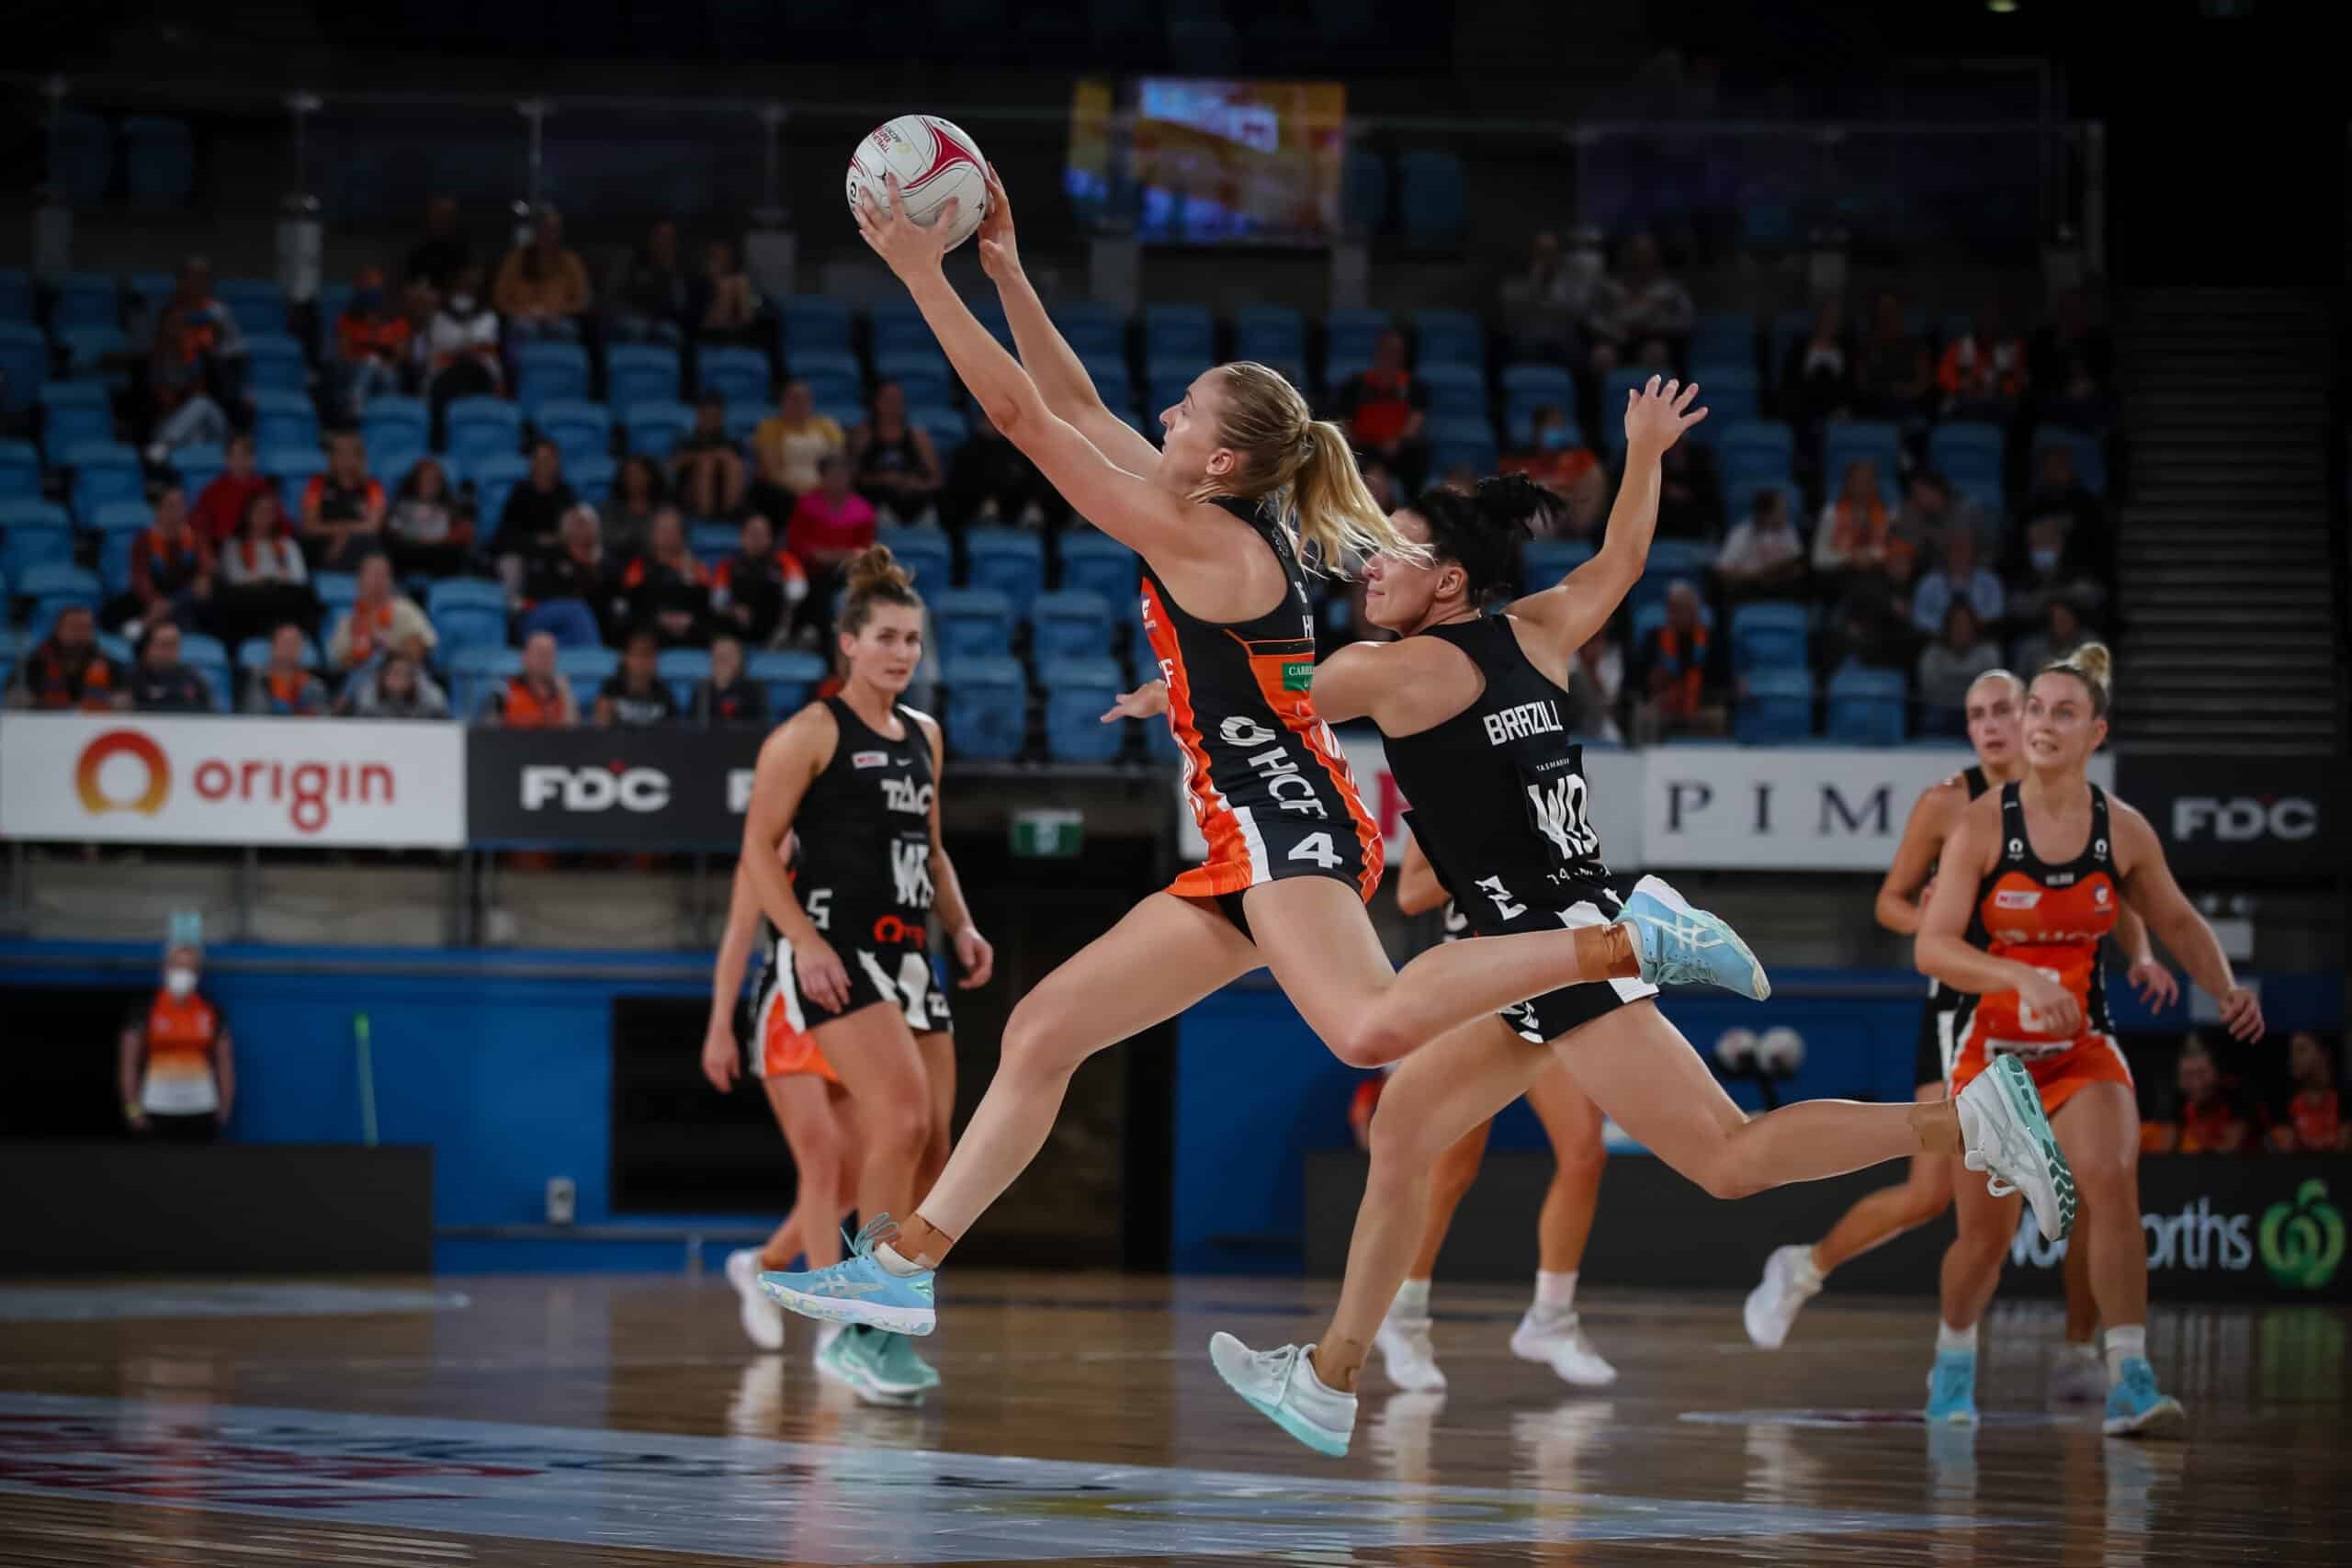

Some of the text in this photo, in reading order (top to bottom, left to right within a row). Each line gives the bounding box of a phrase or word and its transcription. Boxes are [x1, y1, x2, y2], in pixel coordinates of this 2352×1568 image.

[192, 758, 399, 833] origin
[520, 765, 670, 812] FDC
[1248, 746, 1329, 819] HCF
[2173, 796, 2317, 841] FDC
[1288, 831, 1343, 869] 4
